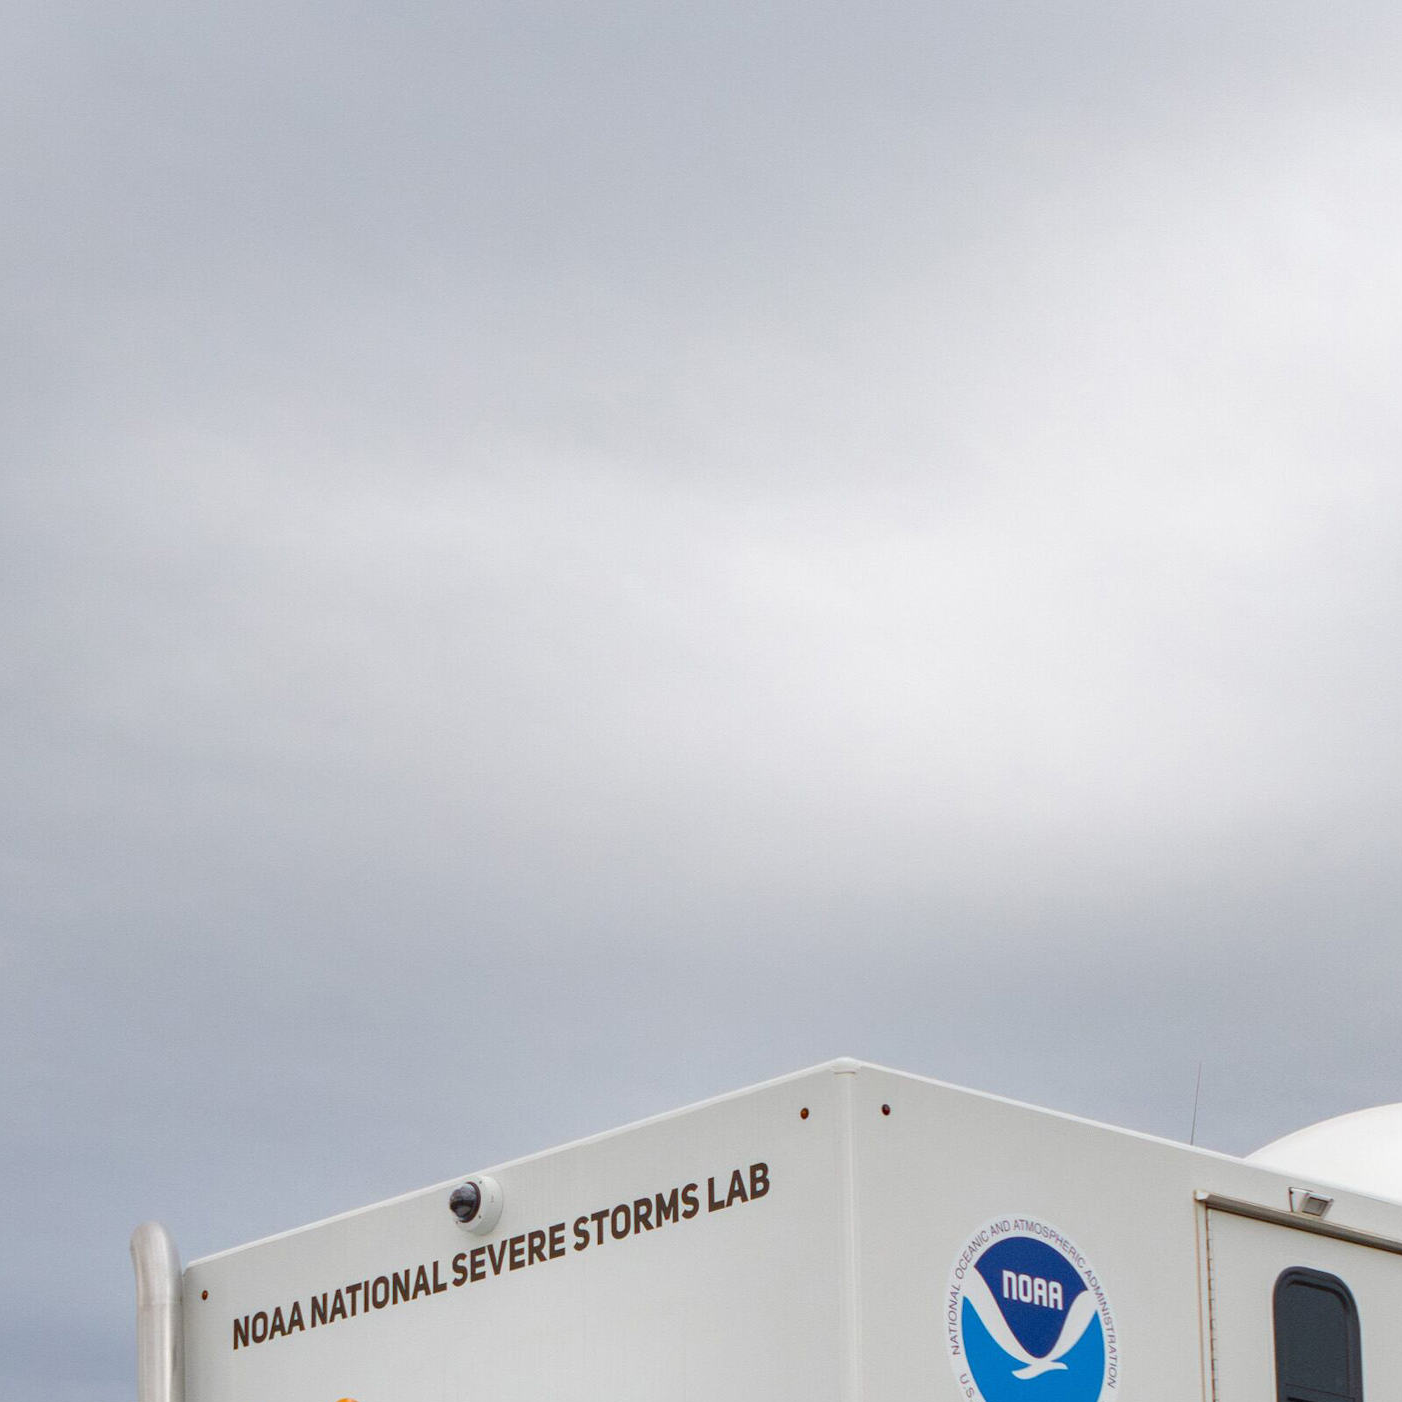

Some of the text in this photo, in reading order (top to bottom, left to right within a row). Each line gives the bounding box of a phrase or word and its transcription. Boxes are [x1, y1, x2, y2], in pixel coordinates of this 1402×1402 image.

[231, 1161, 772, 1352] NOAA NATIONAL SEVERE STORMS LAB
[948, 1218, 1119, 1390] NATIONAL OCEANIC AND ATMOSPHERIC ADMINISTRATION
[1001, 1269, 1064, 1312] NOAA
[959, 1372, 976, 1402] U.S.
